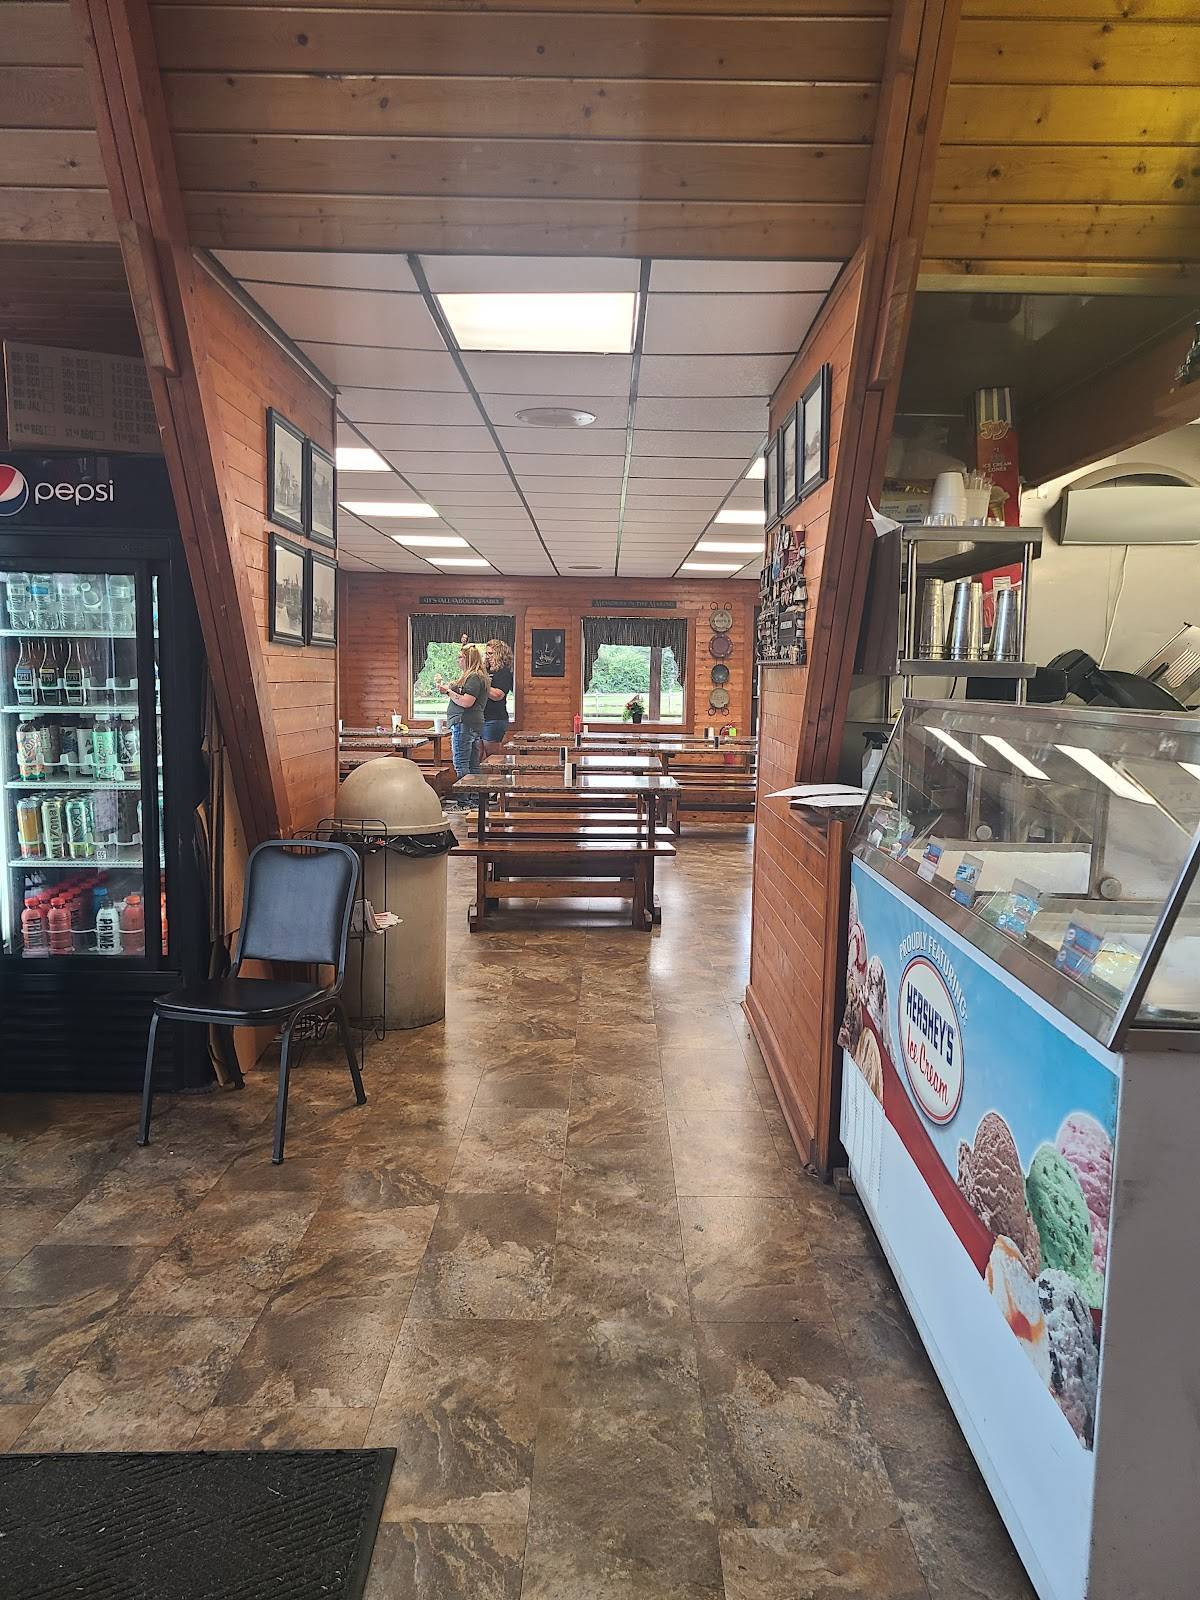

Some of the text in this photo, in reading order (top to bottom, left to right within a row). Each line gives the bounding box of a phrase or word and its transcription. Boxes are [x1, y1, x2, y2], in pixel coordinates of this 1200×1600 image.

[980, 419, 1009, 440] Joy
[35, 480, 114, 506] pepsi
[99, 918, 115, 949] PRIME
[899, 931, 928, 960] PROUDLY
[906, 980, 954, 1066] HERSHEY'S
[906, 1023, 949, 1106] Ice Cream
